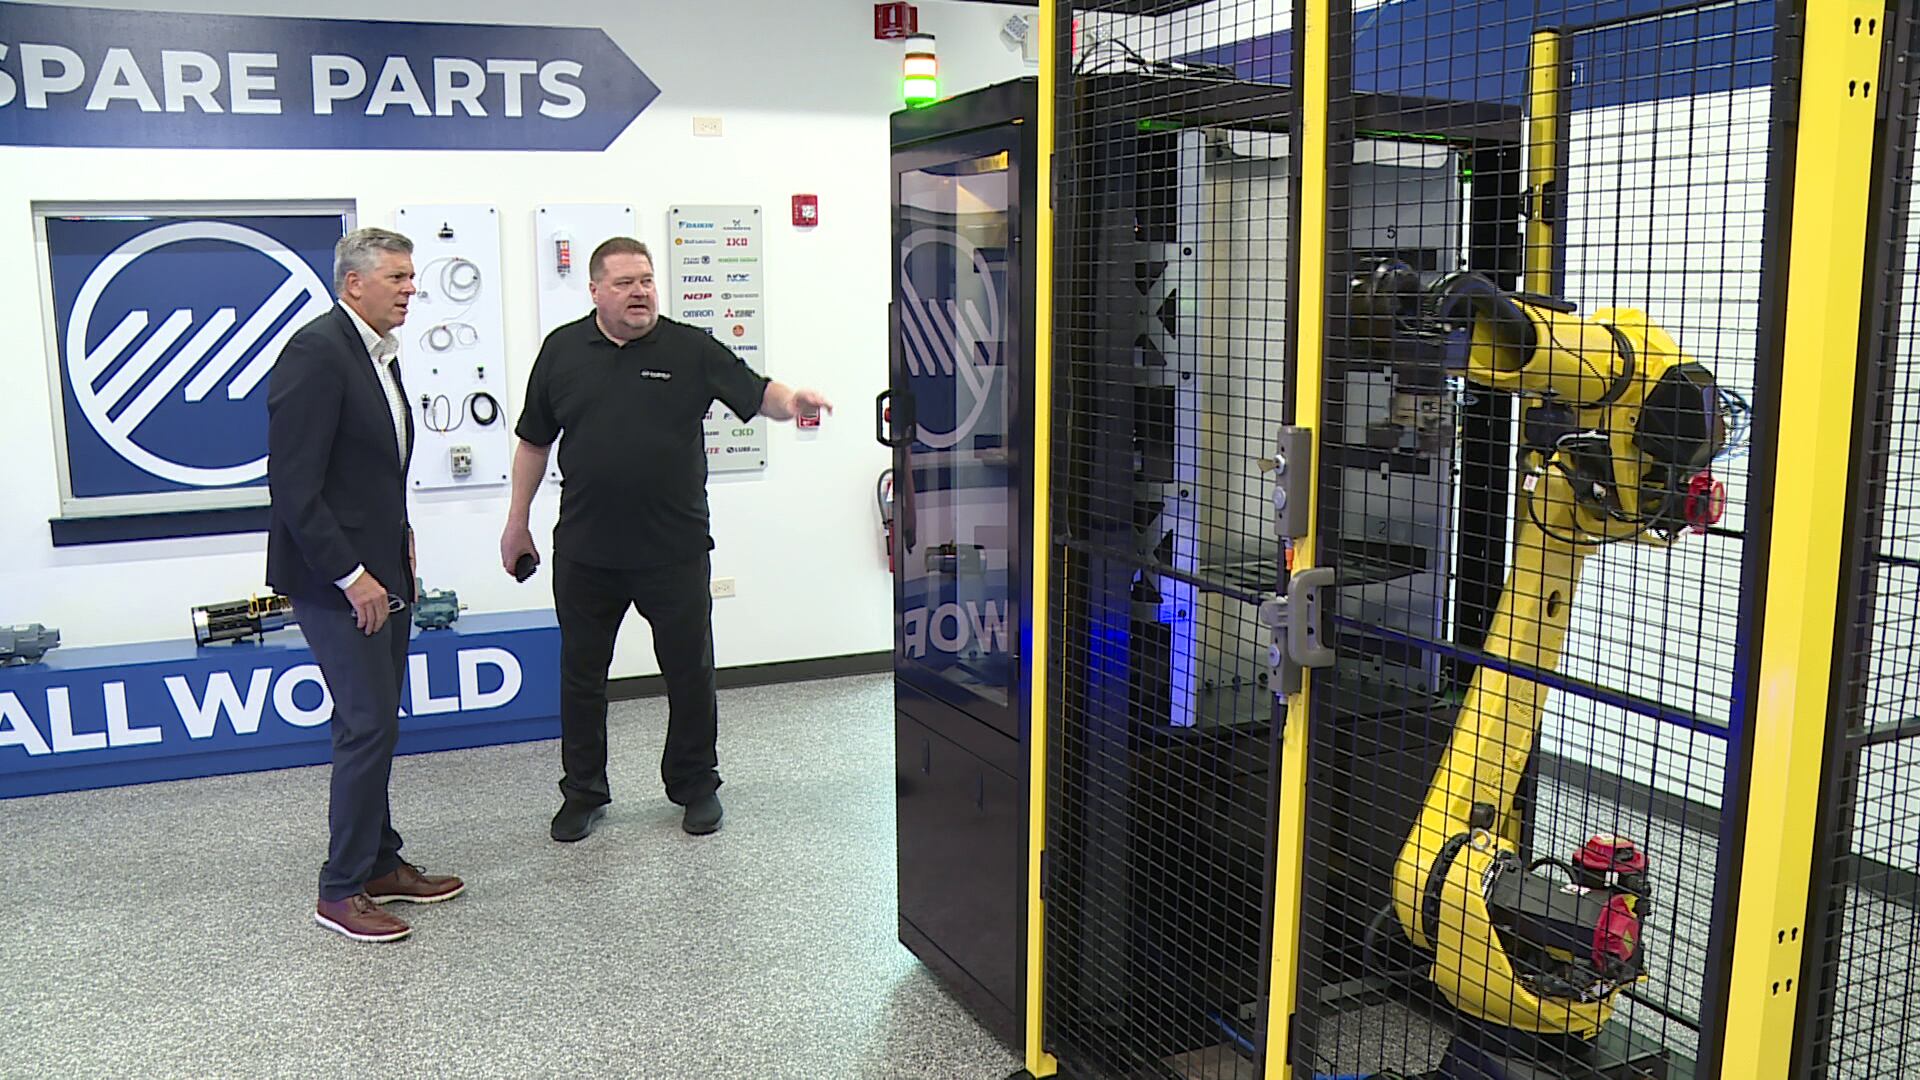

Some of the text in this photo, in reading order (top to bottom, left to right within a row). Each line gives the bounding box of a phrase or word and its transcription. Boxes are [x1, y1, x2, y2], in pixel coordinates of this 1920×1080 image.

[311, 55, 587, 119] PARTS
[1387, 224, 1397, 240] 5
[682, 275, 714, 283] TERAL
[731, 428, 755, 437] CKD
[163, 647, 523, 739] WOLD
